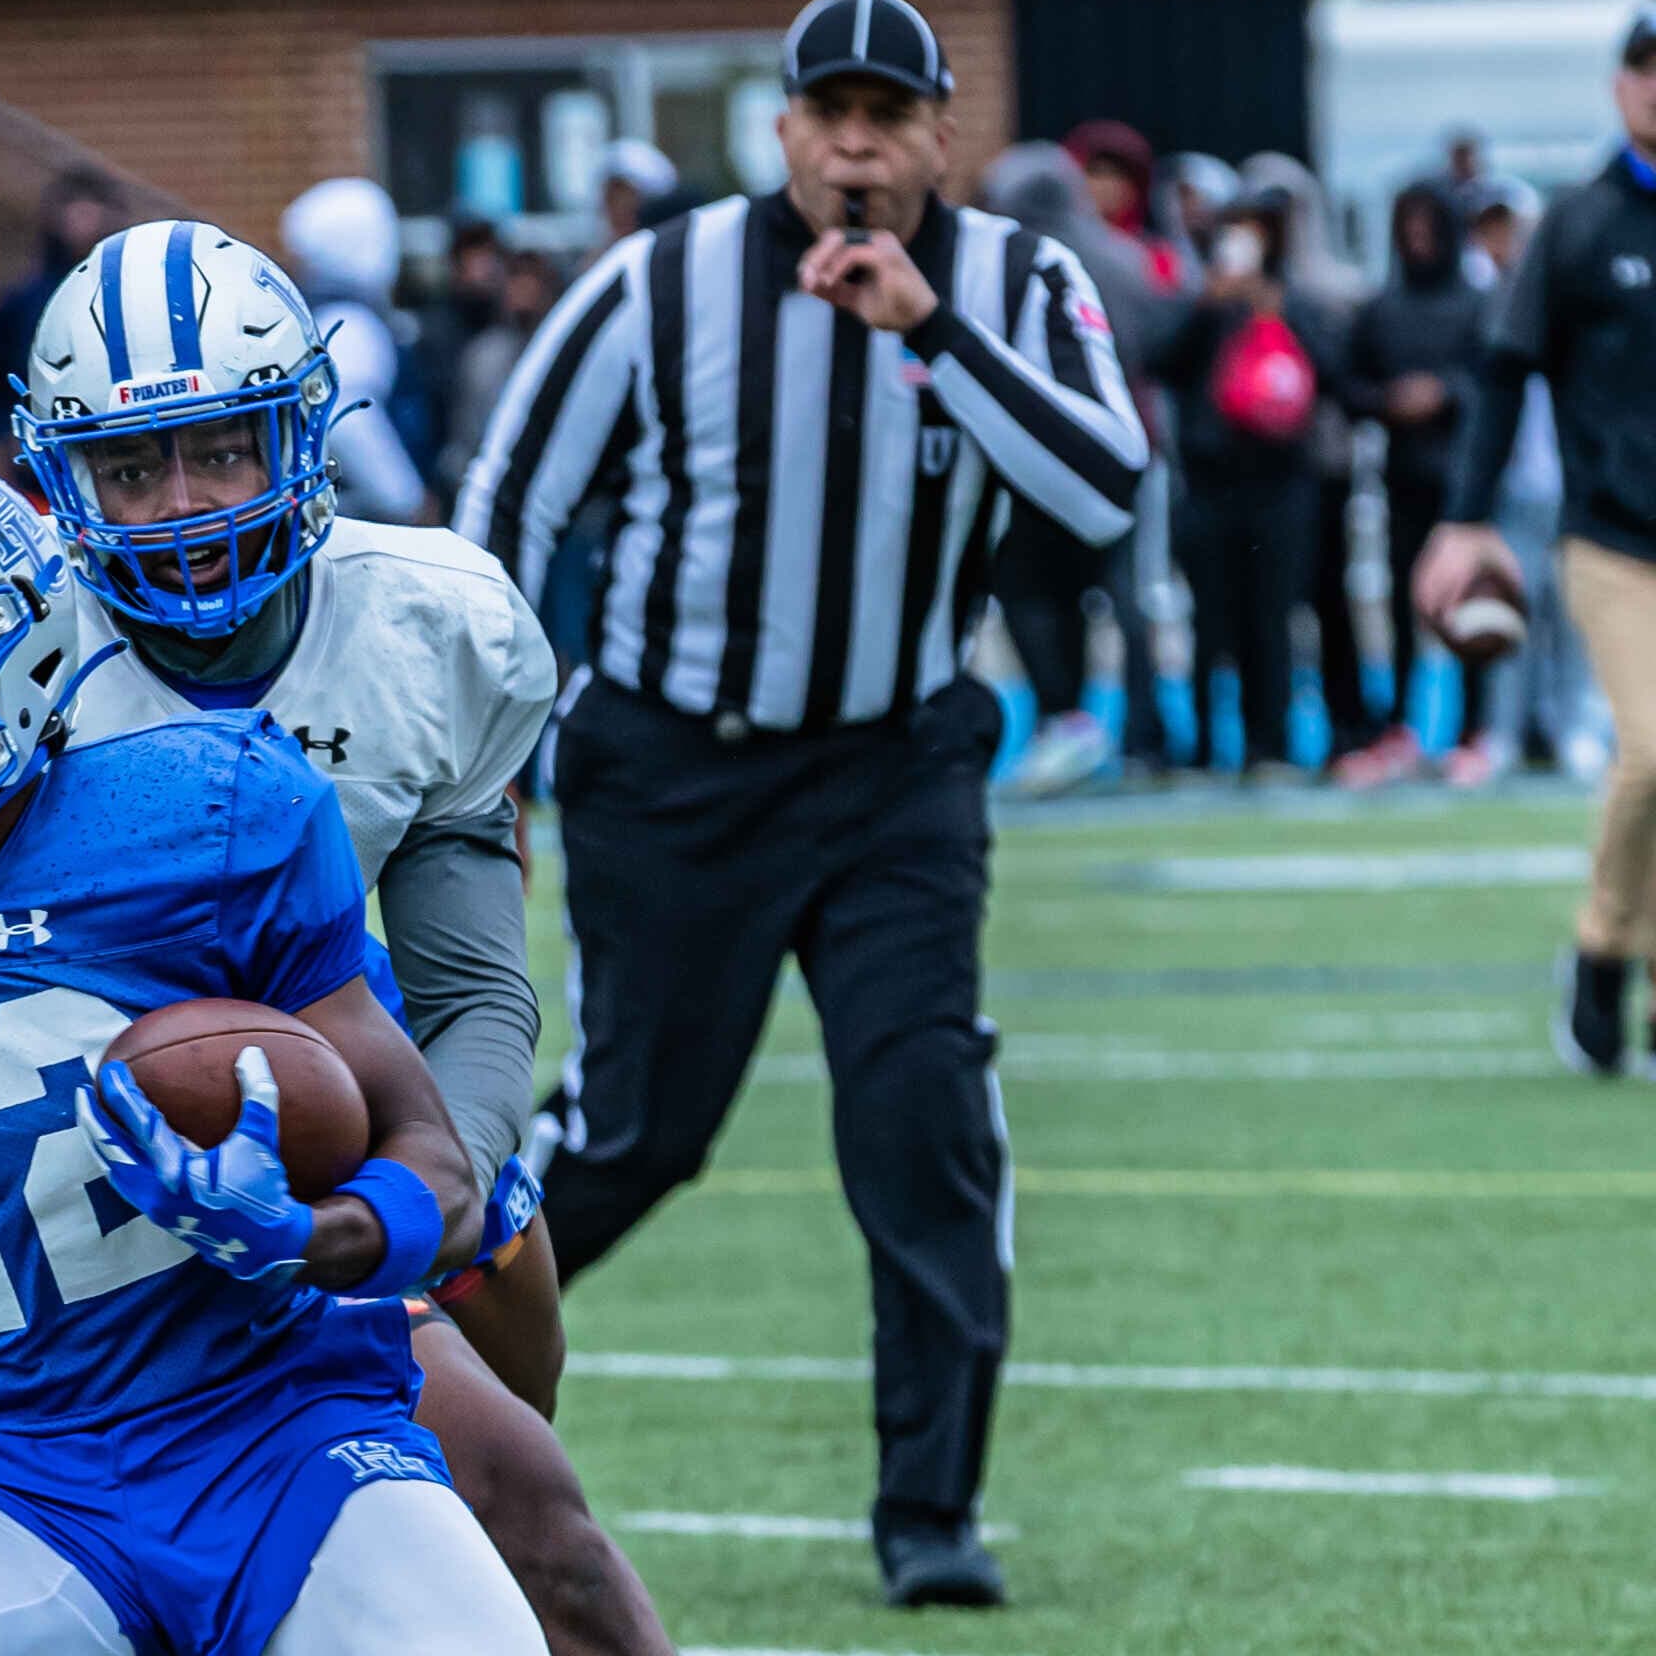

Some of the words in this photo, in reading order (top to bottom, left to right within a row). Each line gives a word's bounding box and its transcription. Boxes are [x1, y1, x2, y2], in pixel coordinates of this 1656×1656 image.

[131, 377, 189, 403] PIRATES
[922, 426, 953, 476] U
[180, 597, 224, 612] Rddell
